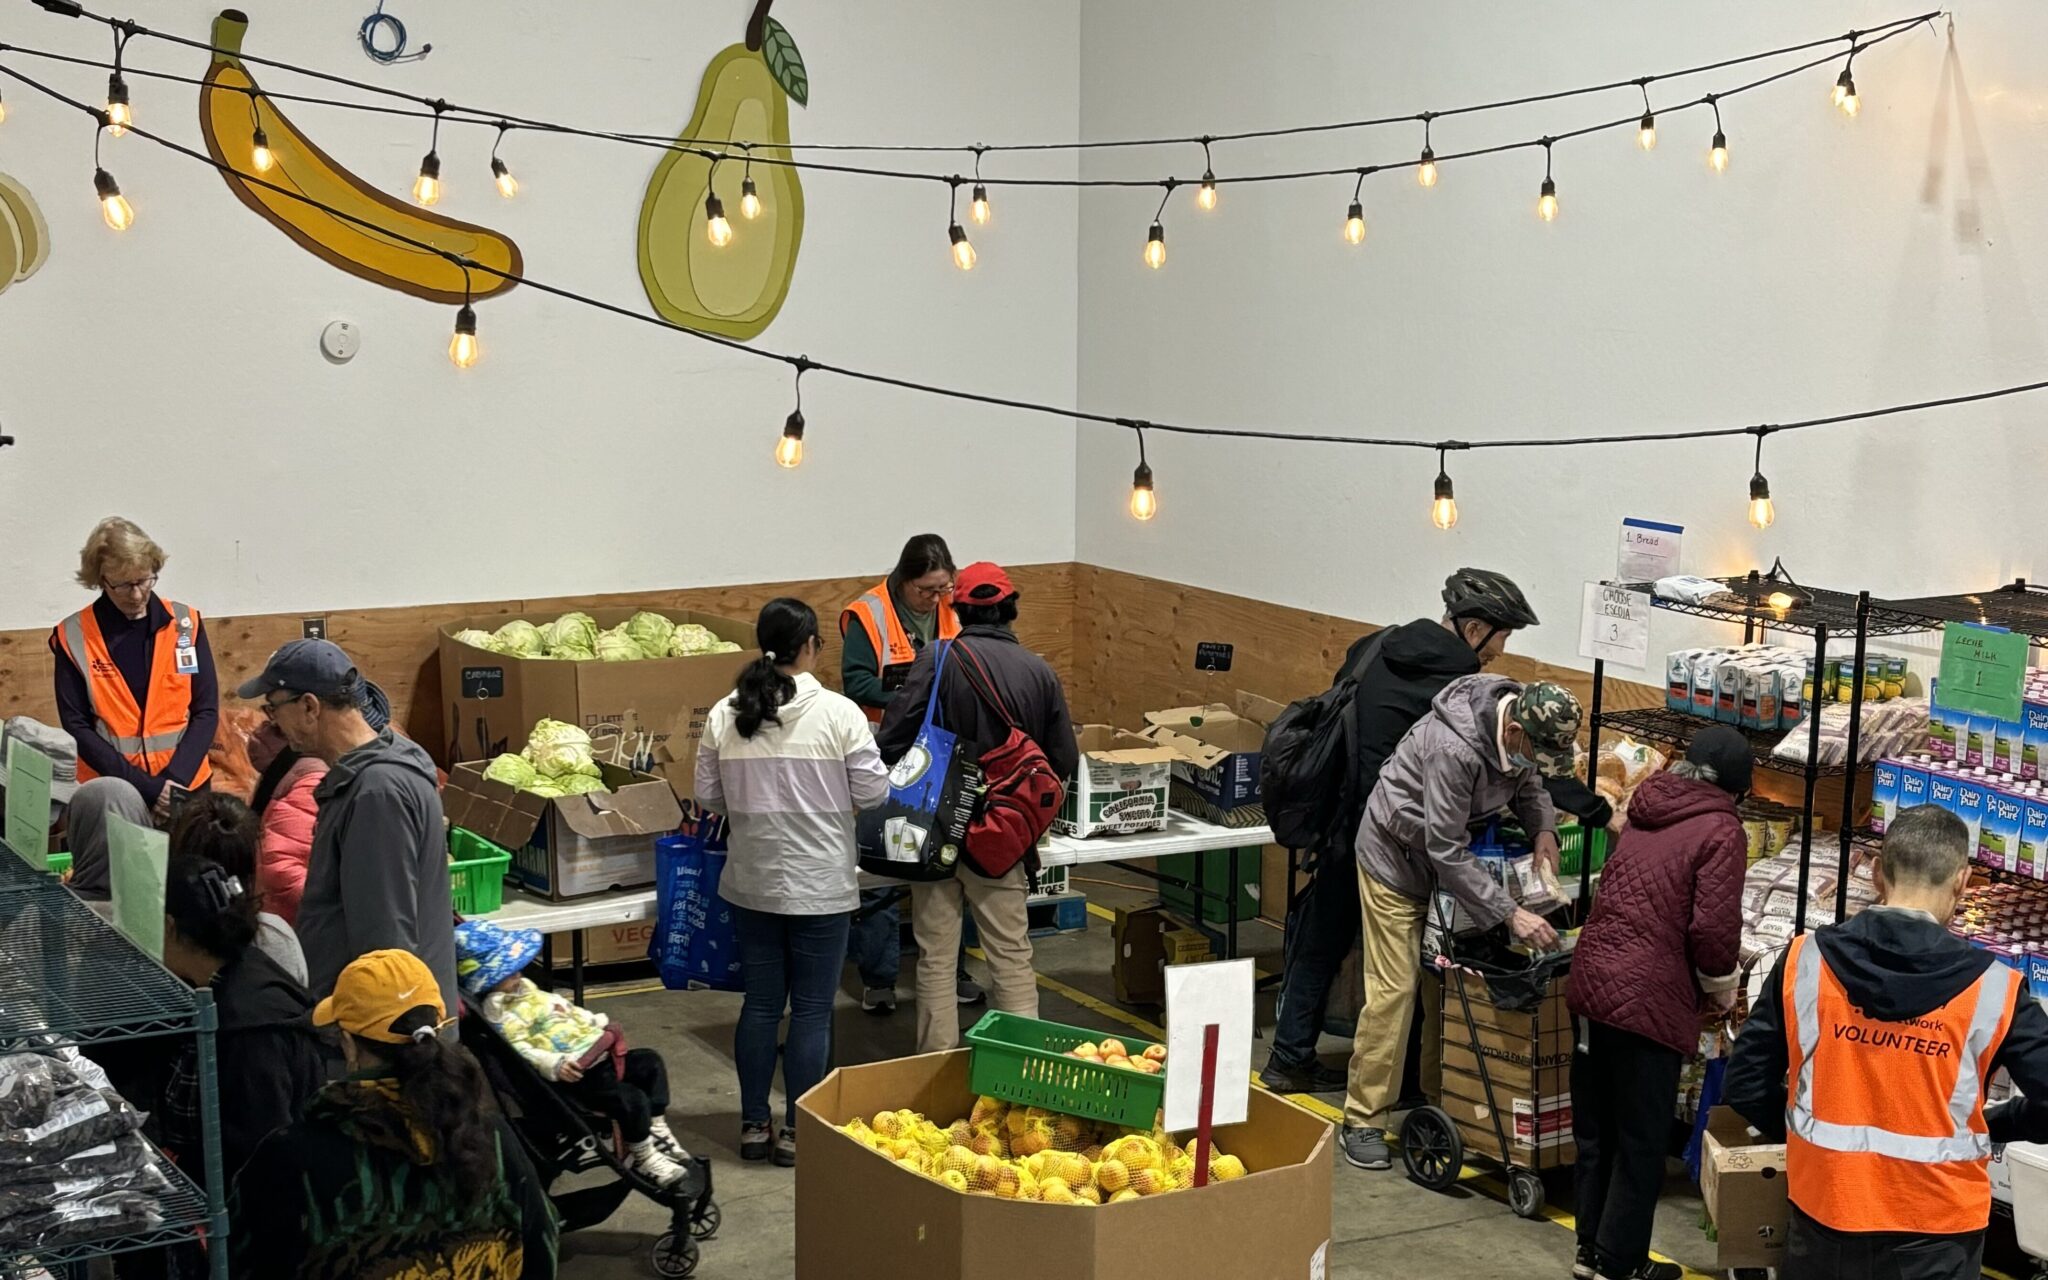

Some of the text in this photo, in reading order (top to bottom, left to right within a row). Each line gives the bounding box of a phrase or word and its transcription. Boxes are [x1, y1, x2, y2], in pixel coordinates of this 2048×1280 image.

[1637, 534, 1659, 545] Bread
[1602, 589, 1632, 607] CHOOSE
[1609, 623, 1619, 641] 3
[1956, 635, 1983, 648] LECHE
[1974, 649, 1997, 661] MILK
[1976, 671, 1982, 686] 1
[2029, 710, 2048, 724] Dair
[1877, 768, 1897, 782] Dairy
[1904, 775, 1924, 788] Dairy
[1877, 776, 1895, 788] Pure
[1904, 783, 1922, 794] Pure
[1932, 781, 1954, 796] Dairy
[1933, 790, 1952, 801] Pure
[1960, 787, 1982, 801] Dairy
[1102, 795, 1155, 818] CALIFORNIA
[1960, 796, 1979, 808] Pure
[1998, 799, 2020, 814] Dairy
[1998, 808, 2018, 821] Pure
[2027, 807, 2048, 821] Dairy
[1094, 820, 1162, 832] SWEET POTATOES
[2027, 816, 2046, 828] Pure
[2032, 962, 2048, 974] Dai
[1897, 1017, 1944, 1032] twork
[1834, 1023, 1950, 1059] VOLUNTEER
